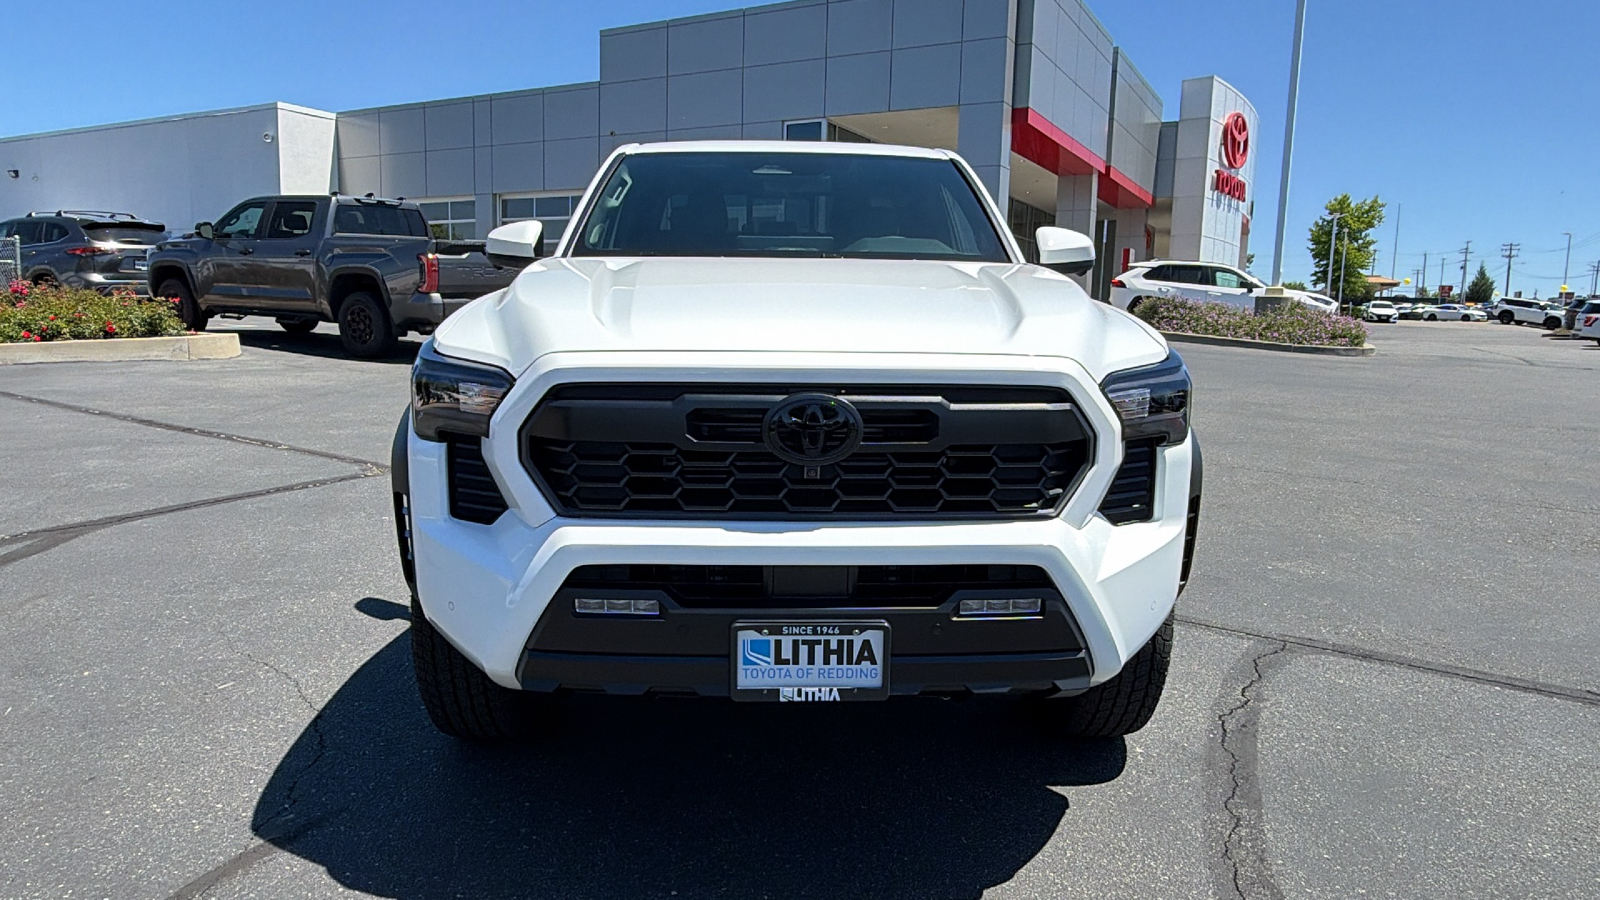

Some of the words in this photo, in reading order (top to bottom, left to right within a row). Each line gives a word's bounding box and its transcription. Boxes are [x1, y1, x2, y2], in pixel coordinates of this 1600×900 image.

[1215, 170, 1246, 203] TOYOTA
[782, 626, 813, 635] SINCE
[816, 626, 840, 635] 1946
[773, 639, 878, 666] LITHIA
[742, 667, 792, 679] TOYOTA
[796, 667, 814, 679] OF
[817, 667, 878, 679] REDDING
[793, 687, 841, 702] LITHIA
